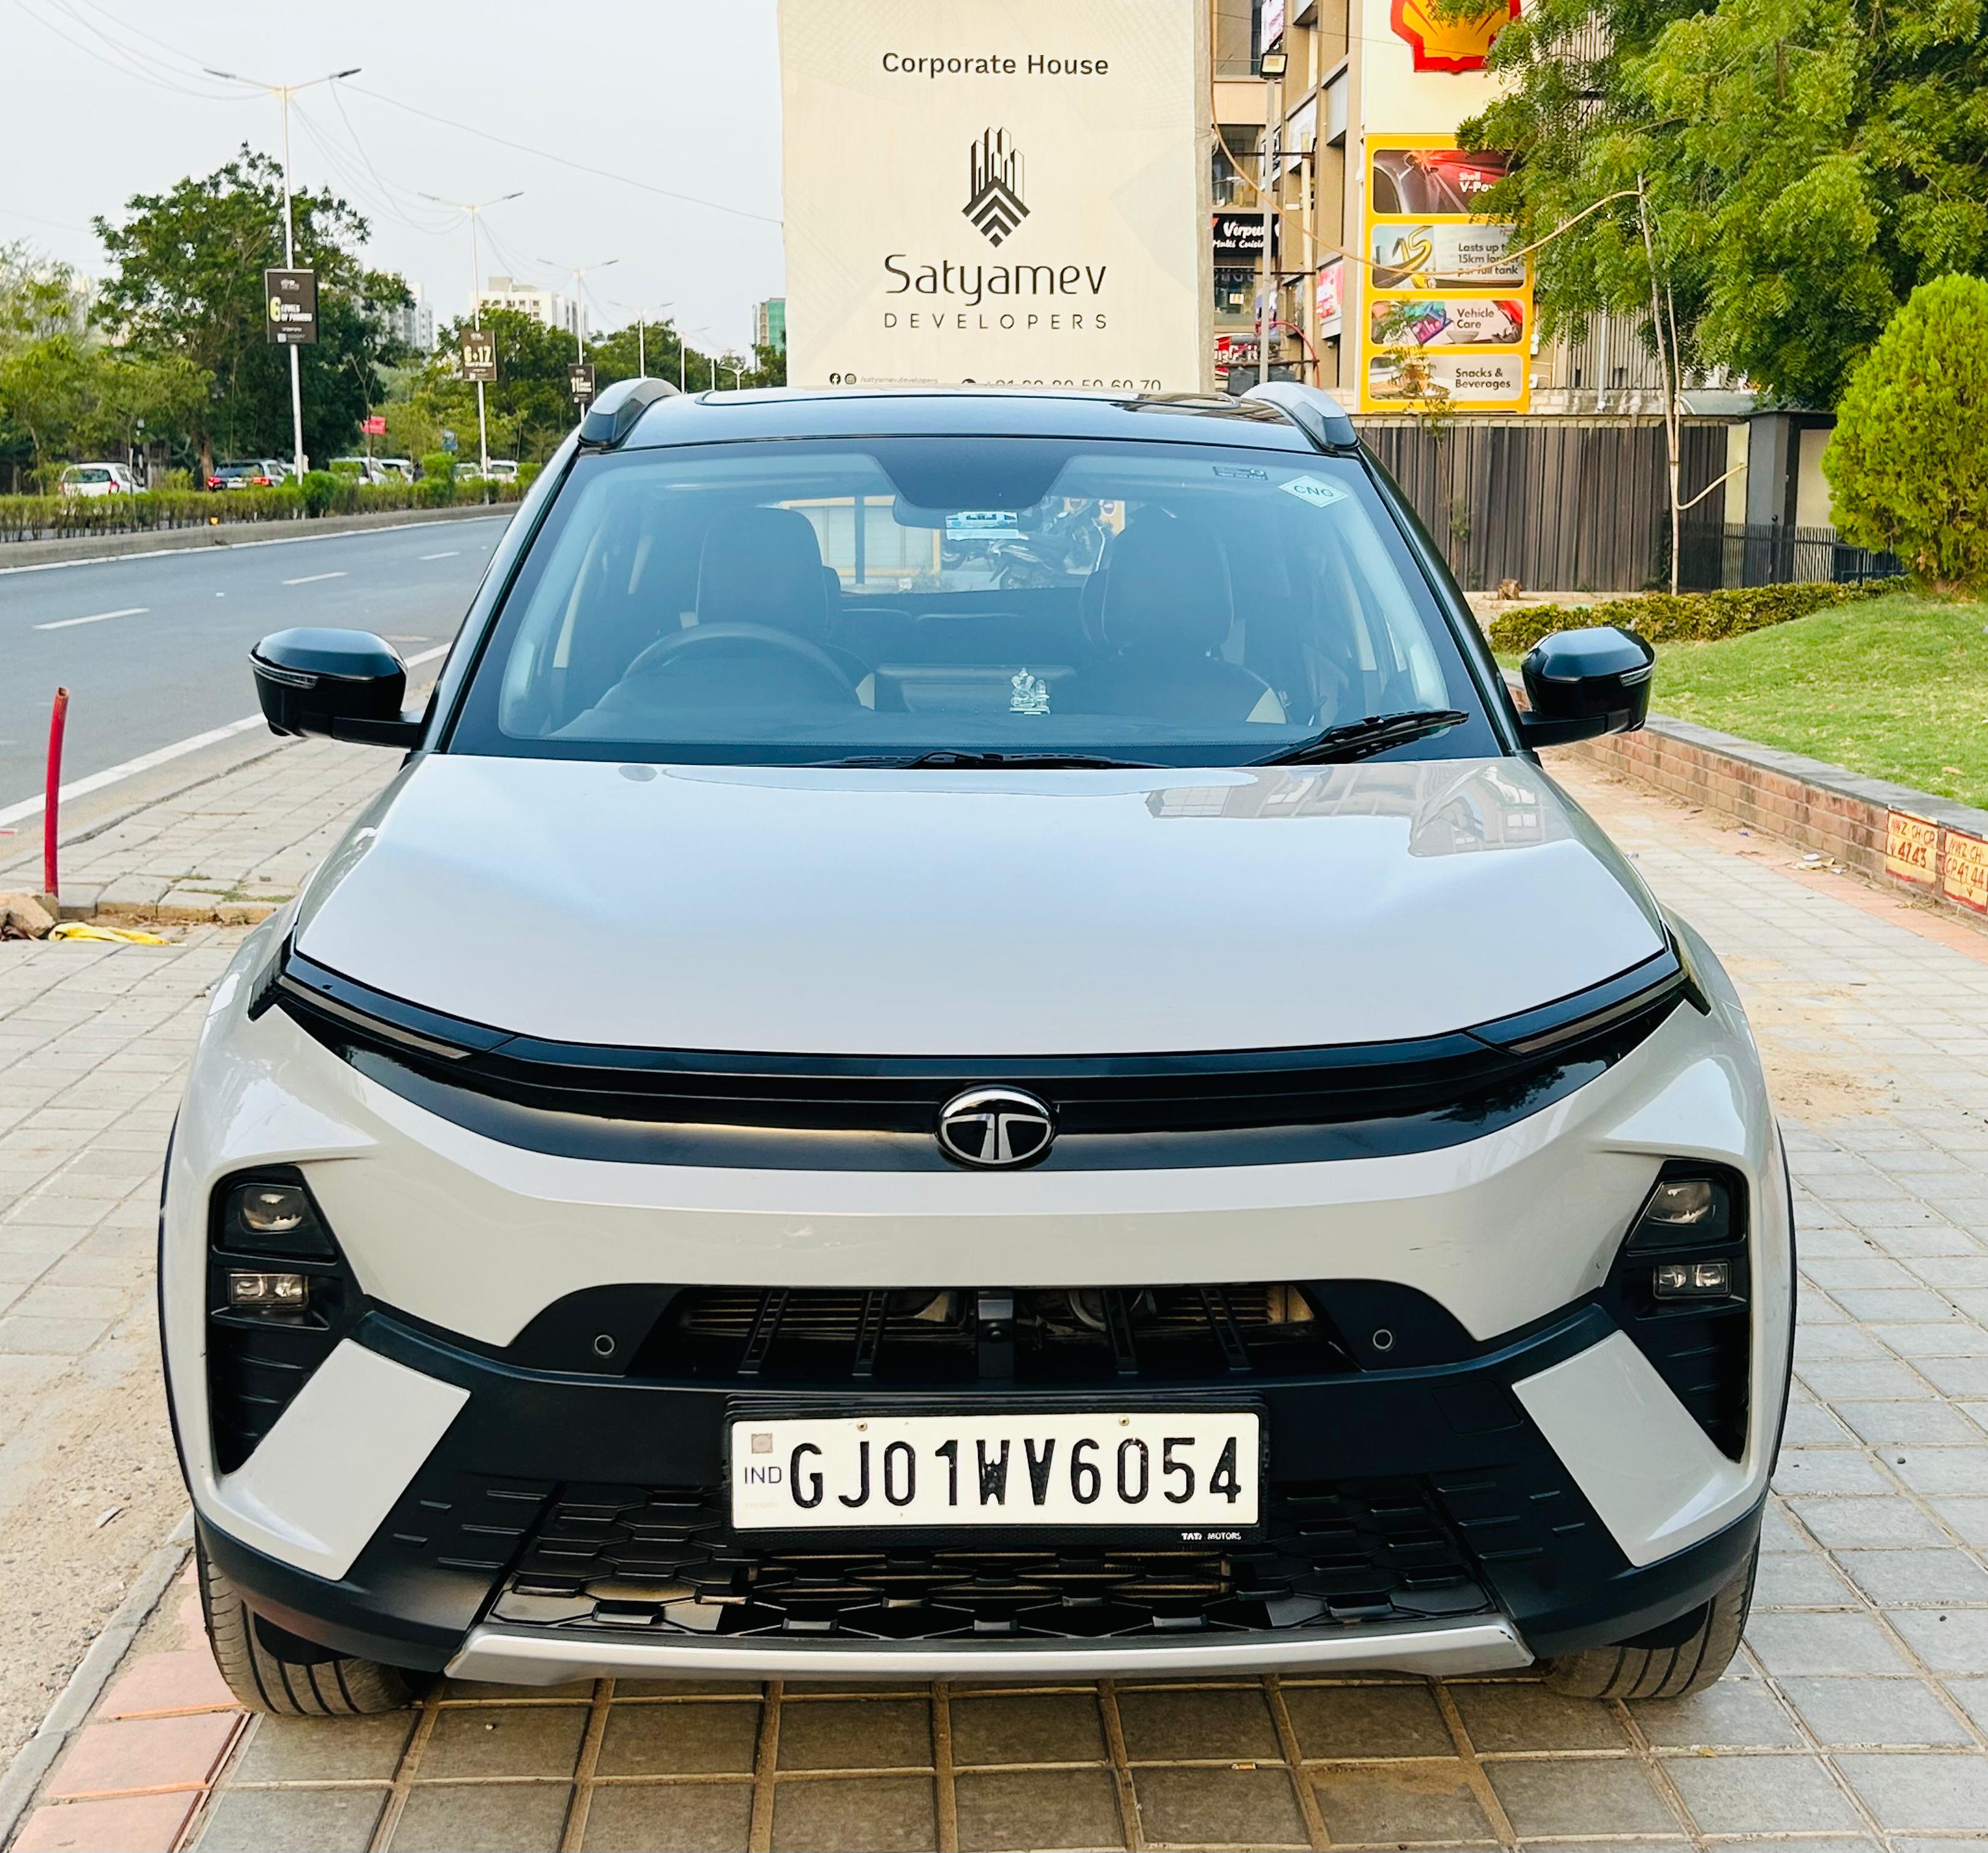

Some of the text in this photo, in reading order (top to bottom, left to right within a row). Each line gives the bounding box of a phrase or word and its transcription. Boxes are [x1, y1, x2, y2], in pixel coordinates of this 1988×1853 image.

[882, 53, 1110, 79] Corporate House
[1459, 171, 1481, 181] Shell
[1459, 181, 1495, 193] V-Po
[1223, 221, 1264, 239] Virpu
[1458, 243, 1484, 252] Lasts
[1485, 245, 1499, 254] up
[1458, 254, 1484, 264] 15km
[1495, 264, 1519, 275] tank
[884, 254, 1107, 307] Satyamev
[1457, 308, 1495, 318] Vehicle
[884, 313, 1107, 331] DEVELOPERS
[1457, 319, 1482, 329] Care
[1455, 368, 1503, 378] Snacks &
[1140, 379, 1161, 390] 70
[1455, 379, 1511, 390] Beverages
[744, 1437, 1242, 1509] IND GJ01WV6054
